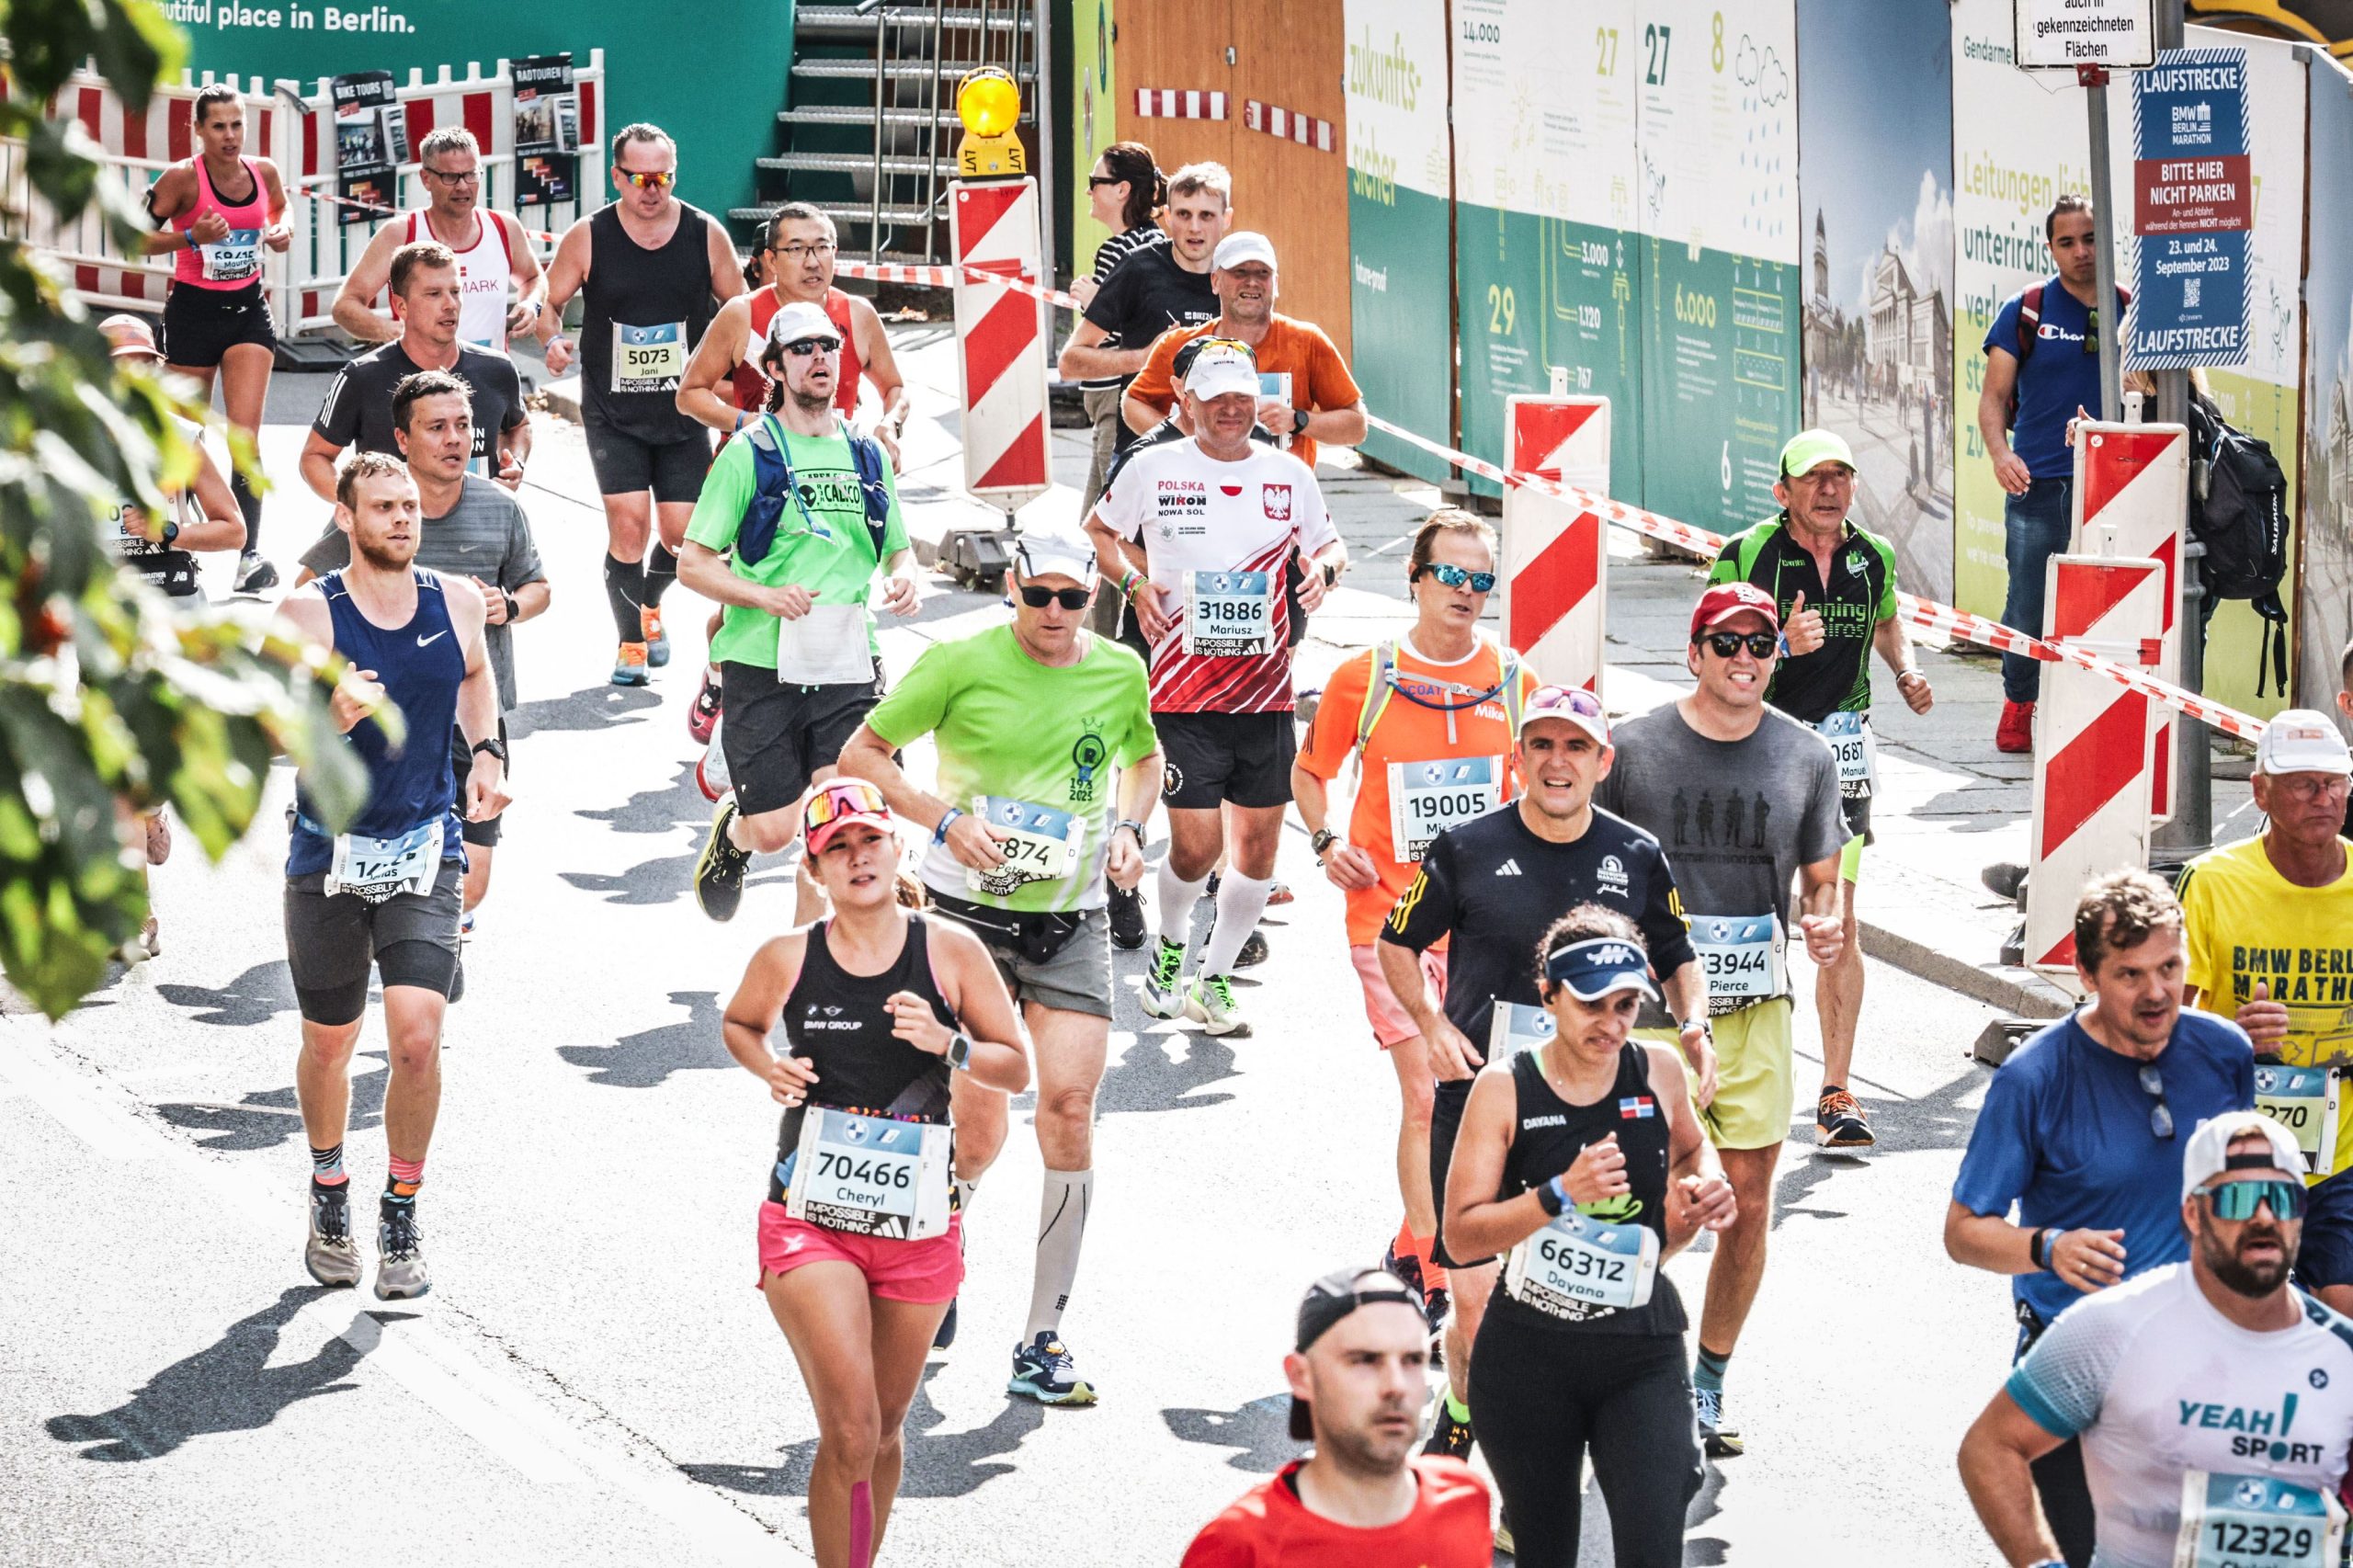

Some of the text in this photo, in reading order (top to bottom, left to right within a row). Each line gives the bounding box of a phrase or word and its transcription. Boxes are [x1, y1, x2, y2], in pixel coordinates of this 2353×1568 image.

[158, 0, 415, 33] autiful place in Berlin.
[2037, 17, 2134, 38] gekennzeichneten
[1462, 21, 1500, 43] 14.000
[1711, 10, 1724, 74] 8
[1597, 26, 1619, 77] 27
[1644, 22, 1671, 86] 27
[1963, 36, 2012, 65] Gendarme
[2065, 41, 2108, 58] Flächen
[516, 66, 562, 83] RADTOUREN
[1350, 24, 1422, 113] zukunfts-
[335, 80, 381, 99] BIKE TOURS
[2143, 67, 2238, 94] LAUFSTRECKE
[2172, 106, 2197, 121] BMW
[2172, 121, 2198, 133] BERLIN
[2172, 133, 2211, 145] MARATHON
[964, 149, 977, 173] LVT
[1008, 147, 1021, 171] LVT
[1353, 120, 1396, 207] sicher
[2161, 161, 2224, 182] BITTE HIER
[1964, 150, 2052, 217] Leitungen
[2151, 183, 2235, 206] NICHT PARKEN
[2172, 206, 2214, 218] An- und Abfahrt
[2145, 216, 2242, 232] während der Rennen NICHT möglich!
[1581, 240, 1609, 267] 3.000
[2168, 238, 2218, 256] 23. und 24.
[2155, 256, 2230, 278] September 2023
[461, 278, 499, 293] MARK
[1487, 282, 1517, 335] 29
[1578, 303, 1602, 330] 1.120
[1675, 281, 1717, 330] 6.000
[2137, 325, 2239, 354] LAUFSTRECKE
[628, 348, 670, 365] 5073
[620, 378, 661, 386] IMPOSSIBLE
[641, 368, 659, 376] Jani
[1575, 365, 1593, 389] 767
[628, 385, 660, 393] NOTHING
[1721, 439, 1733, 492] 6
[1158, 481, 1205, 492] POLSKA
[1158, 495, 1207, 506] WIKON
[1199, 601, 1262, 620] 31886
[1780, 596, 1867, 622] Rnning
[1210, 624, 1253, 635] Mariusz
[1195, 639, 1244, 648] IMPOSSIBLE
[1195, 647, 1242, 656] IS NOTHING
[1473, 703, 1506, 722] Mike
[1069, 790, 1093, 802] 2023
[1410, 792, 1486, 818] 19005
[996, 837, 1051, 867] 874
[1700, 949, 1765, 975] 3944
[2233, 946, 2353, 975] BMW BERL
[1710, 980, 1749, 992] Pierce
[1710, 996, 1743, 1006] SSIBLE
[1710, 1006, 1738, 1016] THING
[803, 1021, 862, 1030] BMW GROUP
[1523, 1114, 1566, 1131] DAYANA
[2258, 1105, 2308, 1129] 270
[817, 1152, 911, 1189] 70466
[836, 1187, 886, 1208] Cheryl
[806, 1201, 877, 1223] IMPOSSIBLE
[806, 1212, 871, 1234] IS NOTHING
[1540, 1238, 1627, 1283] 66312
[1525, 1278, 1590, 1313] IMPOSSIBLE
[1547, 1270, 1606, 1300] Dayana
[1520, 1290, 1586, 1324] IS NOTHING
[2232, 1435, 2325, 1465] SPORT
[2211, 1522, 2313, 1560] 12329
